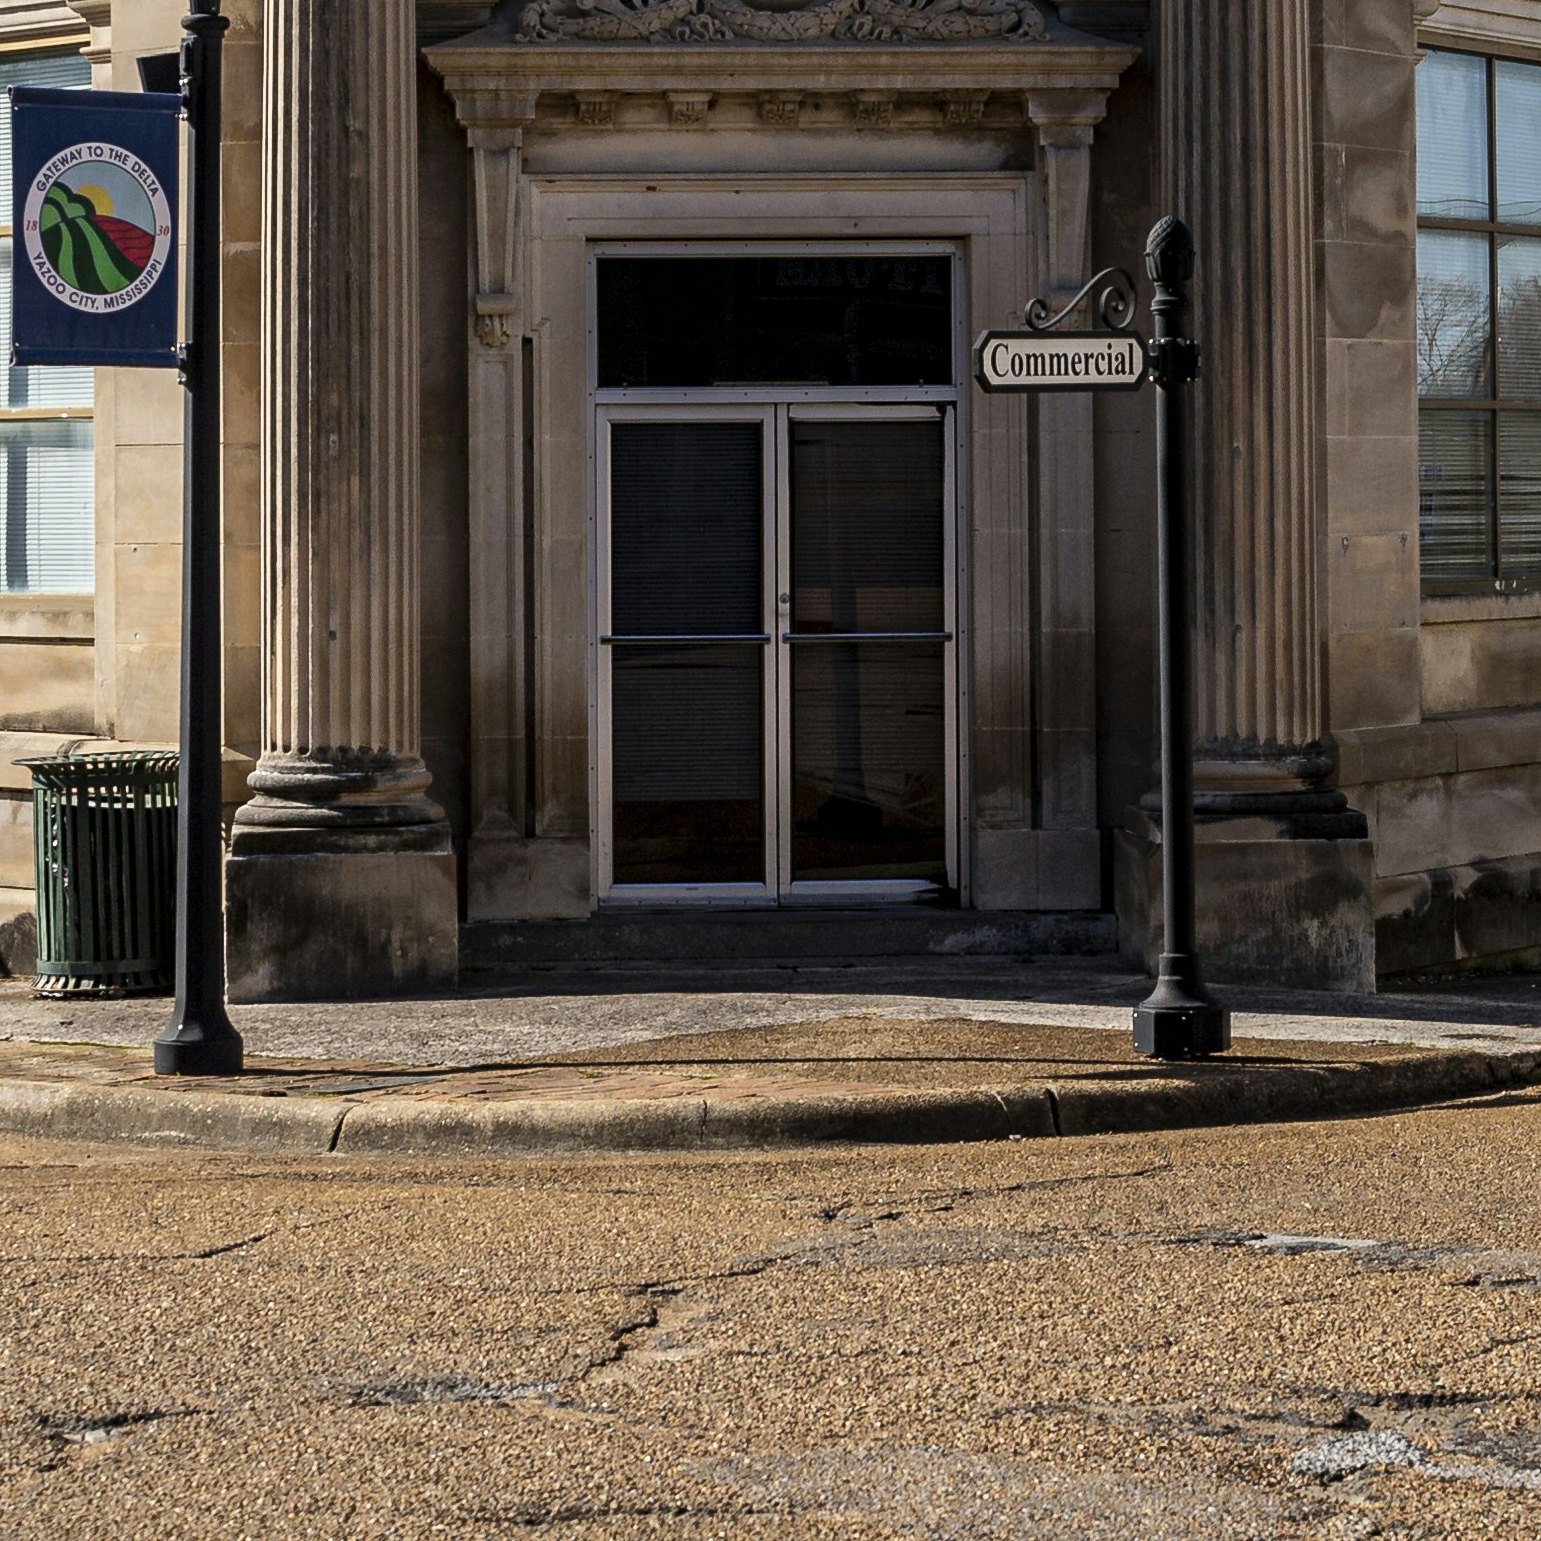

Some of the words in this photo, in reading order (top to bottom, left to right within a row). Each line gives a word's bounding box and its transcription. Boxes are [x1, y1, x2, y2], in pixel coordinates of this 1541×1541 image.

[36, 148, 83, 192] GATEWAY
[87, 145, 104, 158] TO
[108, 148, 130, 166] THE
[131, 161, 160, 197] DELTA
[25, 220, 38, 231] 18
[157, 225, 170, 236] 30
[33, 252, 66, 295] YAZOO
[69, 291, 99, 310] CITY,
[103, 258, 162, 309] MISSISSIPPI
[991, 342, 1135, 378] Commercial
